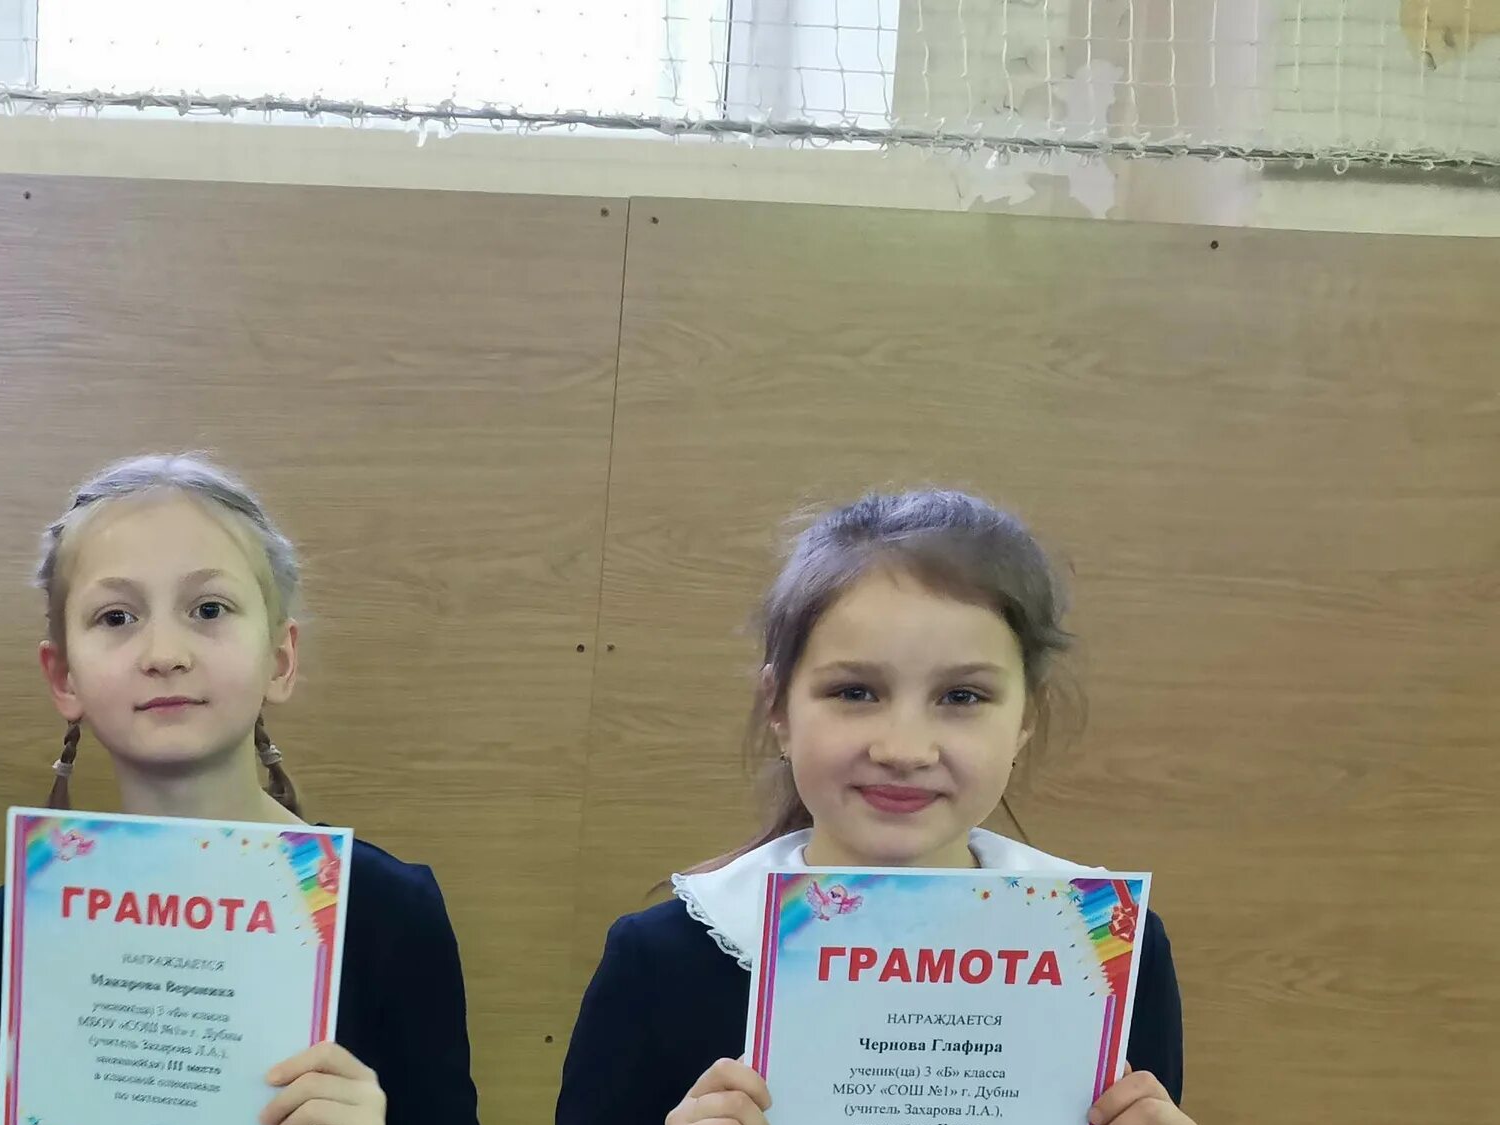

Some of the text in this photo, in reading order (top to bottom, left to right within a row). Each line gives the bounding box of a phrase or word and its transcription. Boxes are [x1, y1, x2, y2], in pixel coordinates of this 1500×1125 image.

[60, 886, 276, 933] ГРАМОТА
[818, 947, 1062, 985] ГРАМОТА
[887, 1013, 1002, 1026] НАГРАЖДАЕТСЯ
[859, 1037, 1002, 1055] Чернова Глафира
[849, 1065, 1005, 1078] ученик(ца) 3 «Б» класса
[833, 1083, 876, 1094] МБОУ
[880, 1084, 923, 1096] «СОШ
[927, 1085, 957, 1096] №1»
[973, 1085, 1019, 1100] Дубны
[844, 1104, 900, 1116] (учитель
[904, 1103, 961, 1118] Захарова
